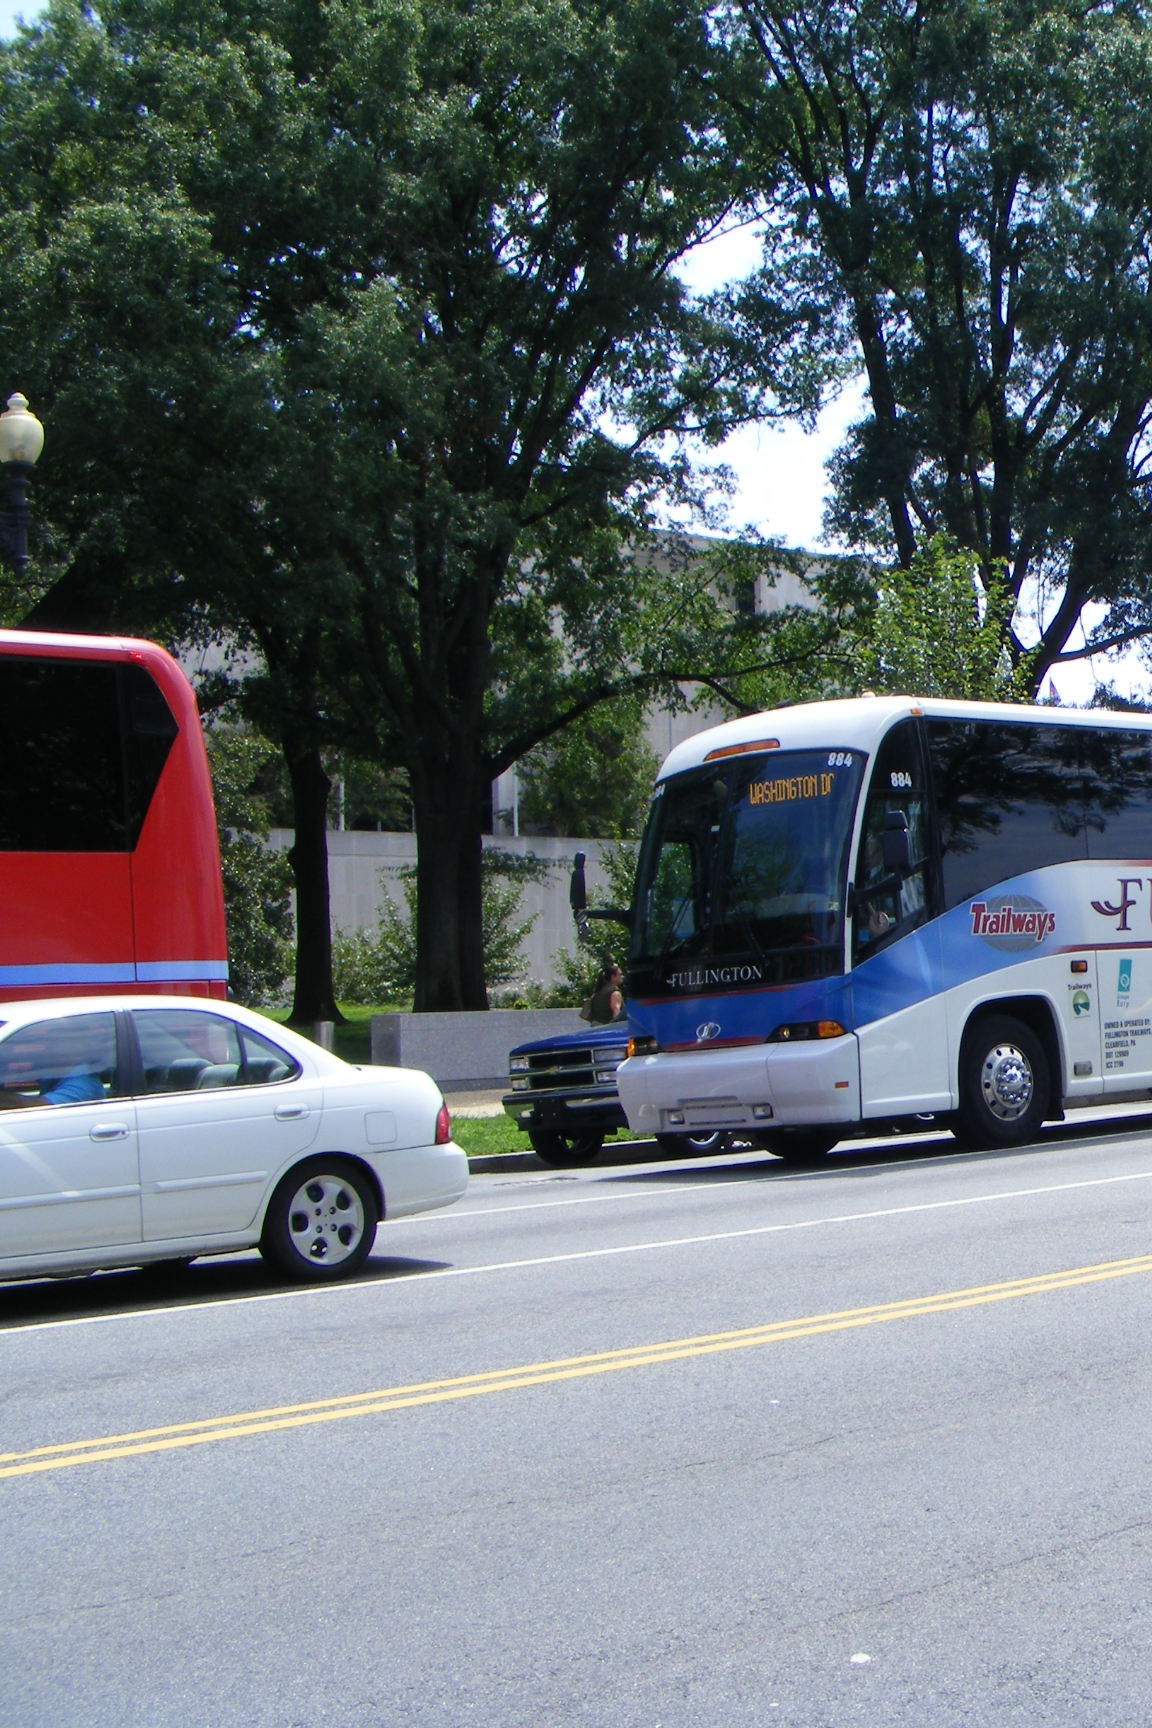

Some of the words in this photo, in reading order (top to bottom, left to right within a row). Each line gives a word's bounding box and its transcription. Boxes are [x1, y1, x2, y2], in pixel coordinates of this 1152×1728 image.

[827, 752, 853, 768] 884
[890, 772, 912, 788] 884
[749, 775, 818, 805] WASHINGTON
[969, 902, 1056, 943] Trailways
[666, 965, 763, 988] FULLINGTON
[1124, 1019, 1144, 1027] OPERATED
[1104, 1030, 1129, 1039] FULLINGTON
